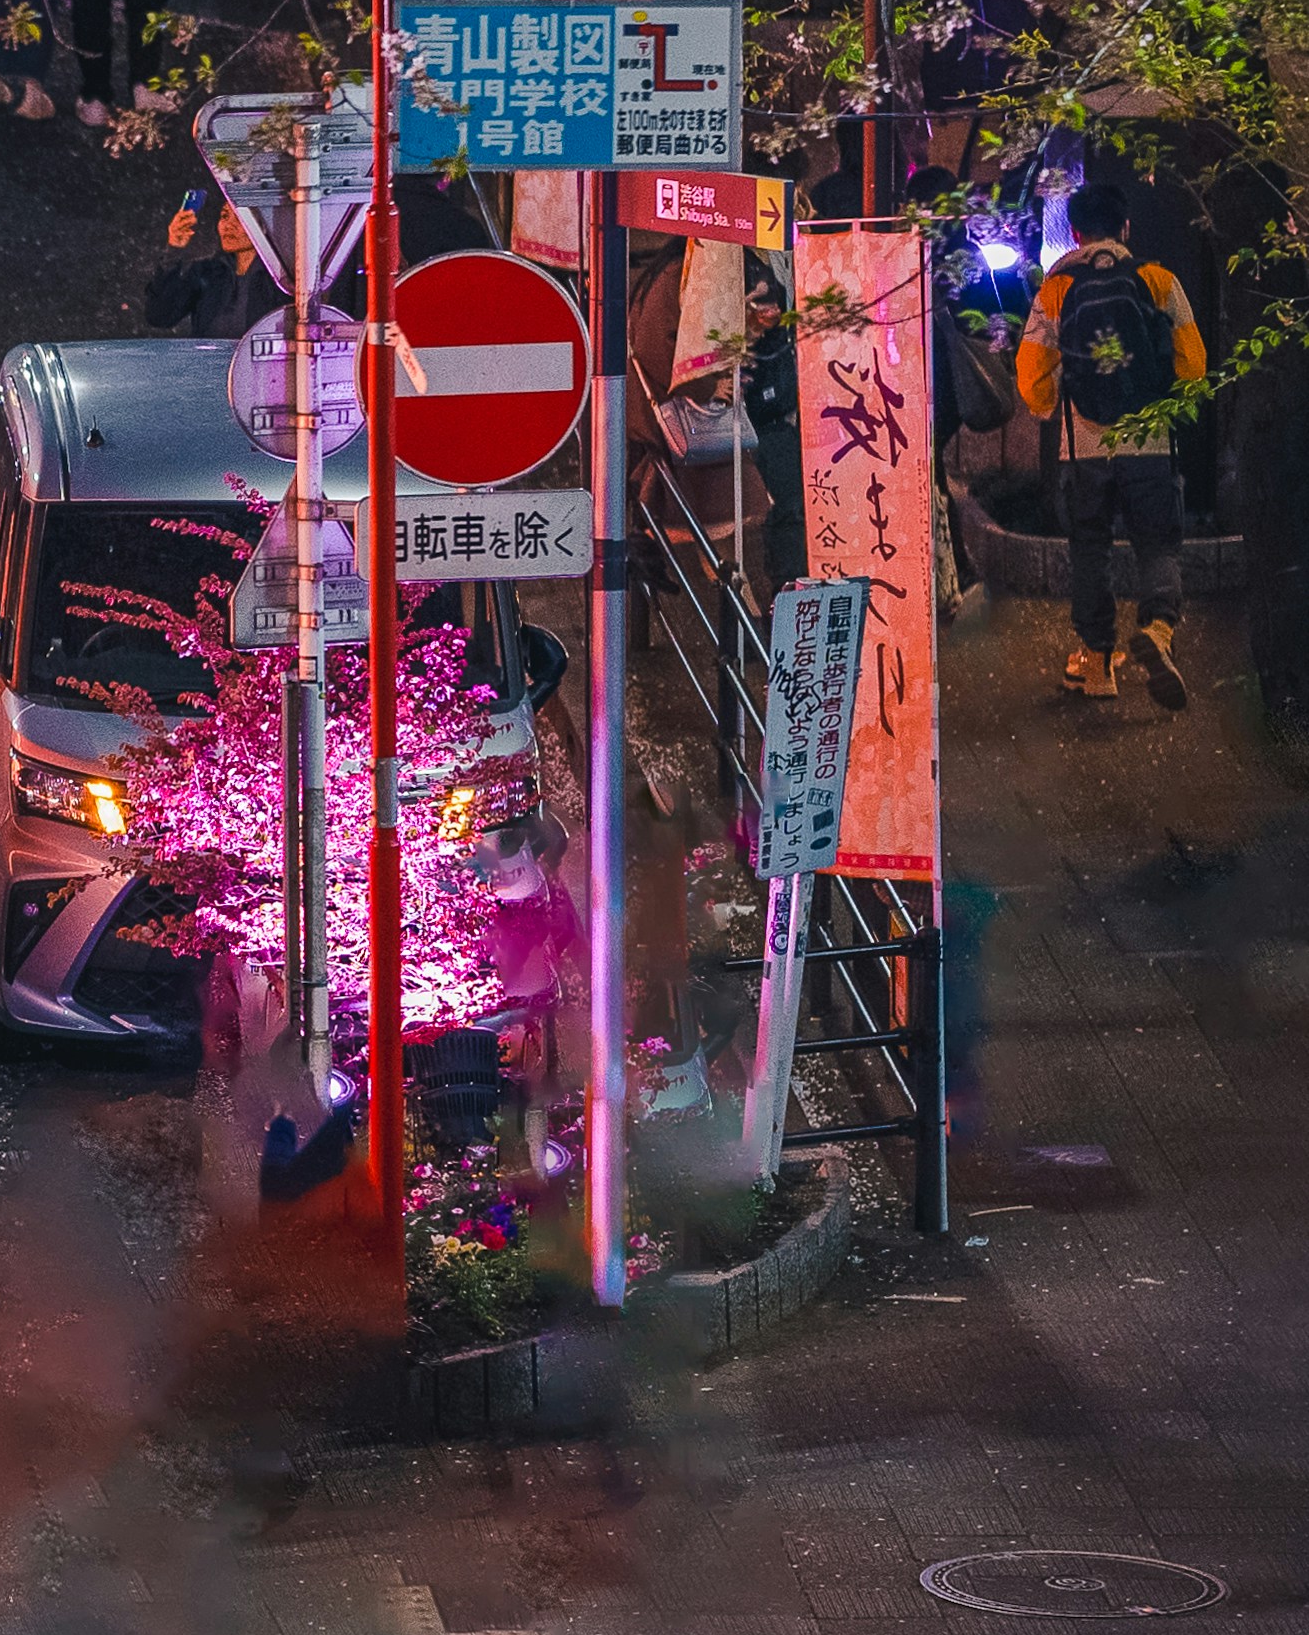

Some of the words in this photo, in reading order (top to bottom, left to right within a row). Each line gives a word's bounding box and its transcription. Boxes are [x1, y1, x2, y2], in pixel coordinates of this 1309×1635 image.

[414, 13, 612, 76] 青山製図
[692, 64, 726, 75] 現在地
[459, 120, 565, 157] 1号館
[616, 134, 728, 156] 郵便局曲がる
[680, 184, 716, 208] 渋谷駅
[680, 207, 713, 228] Shibuya
[714, 212, 731, 228] Sta.
[734, 218, 754, 231] 150m
